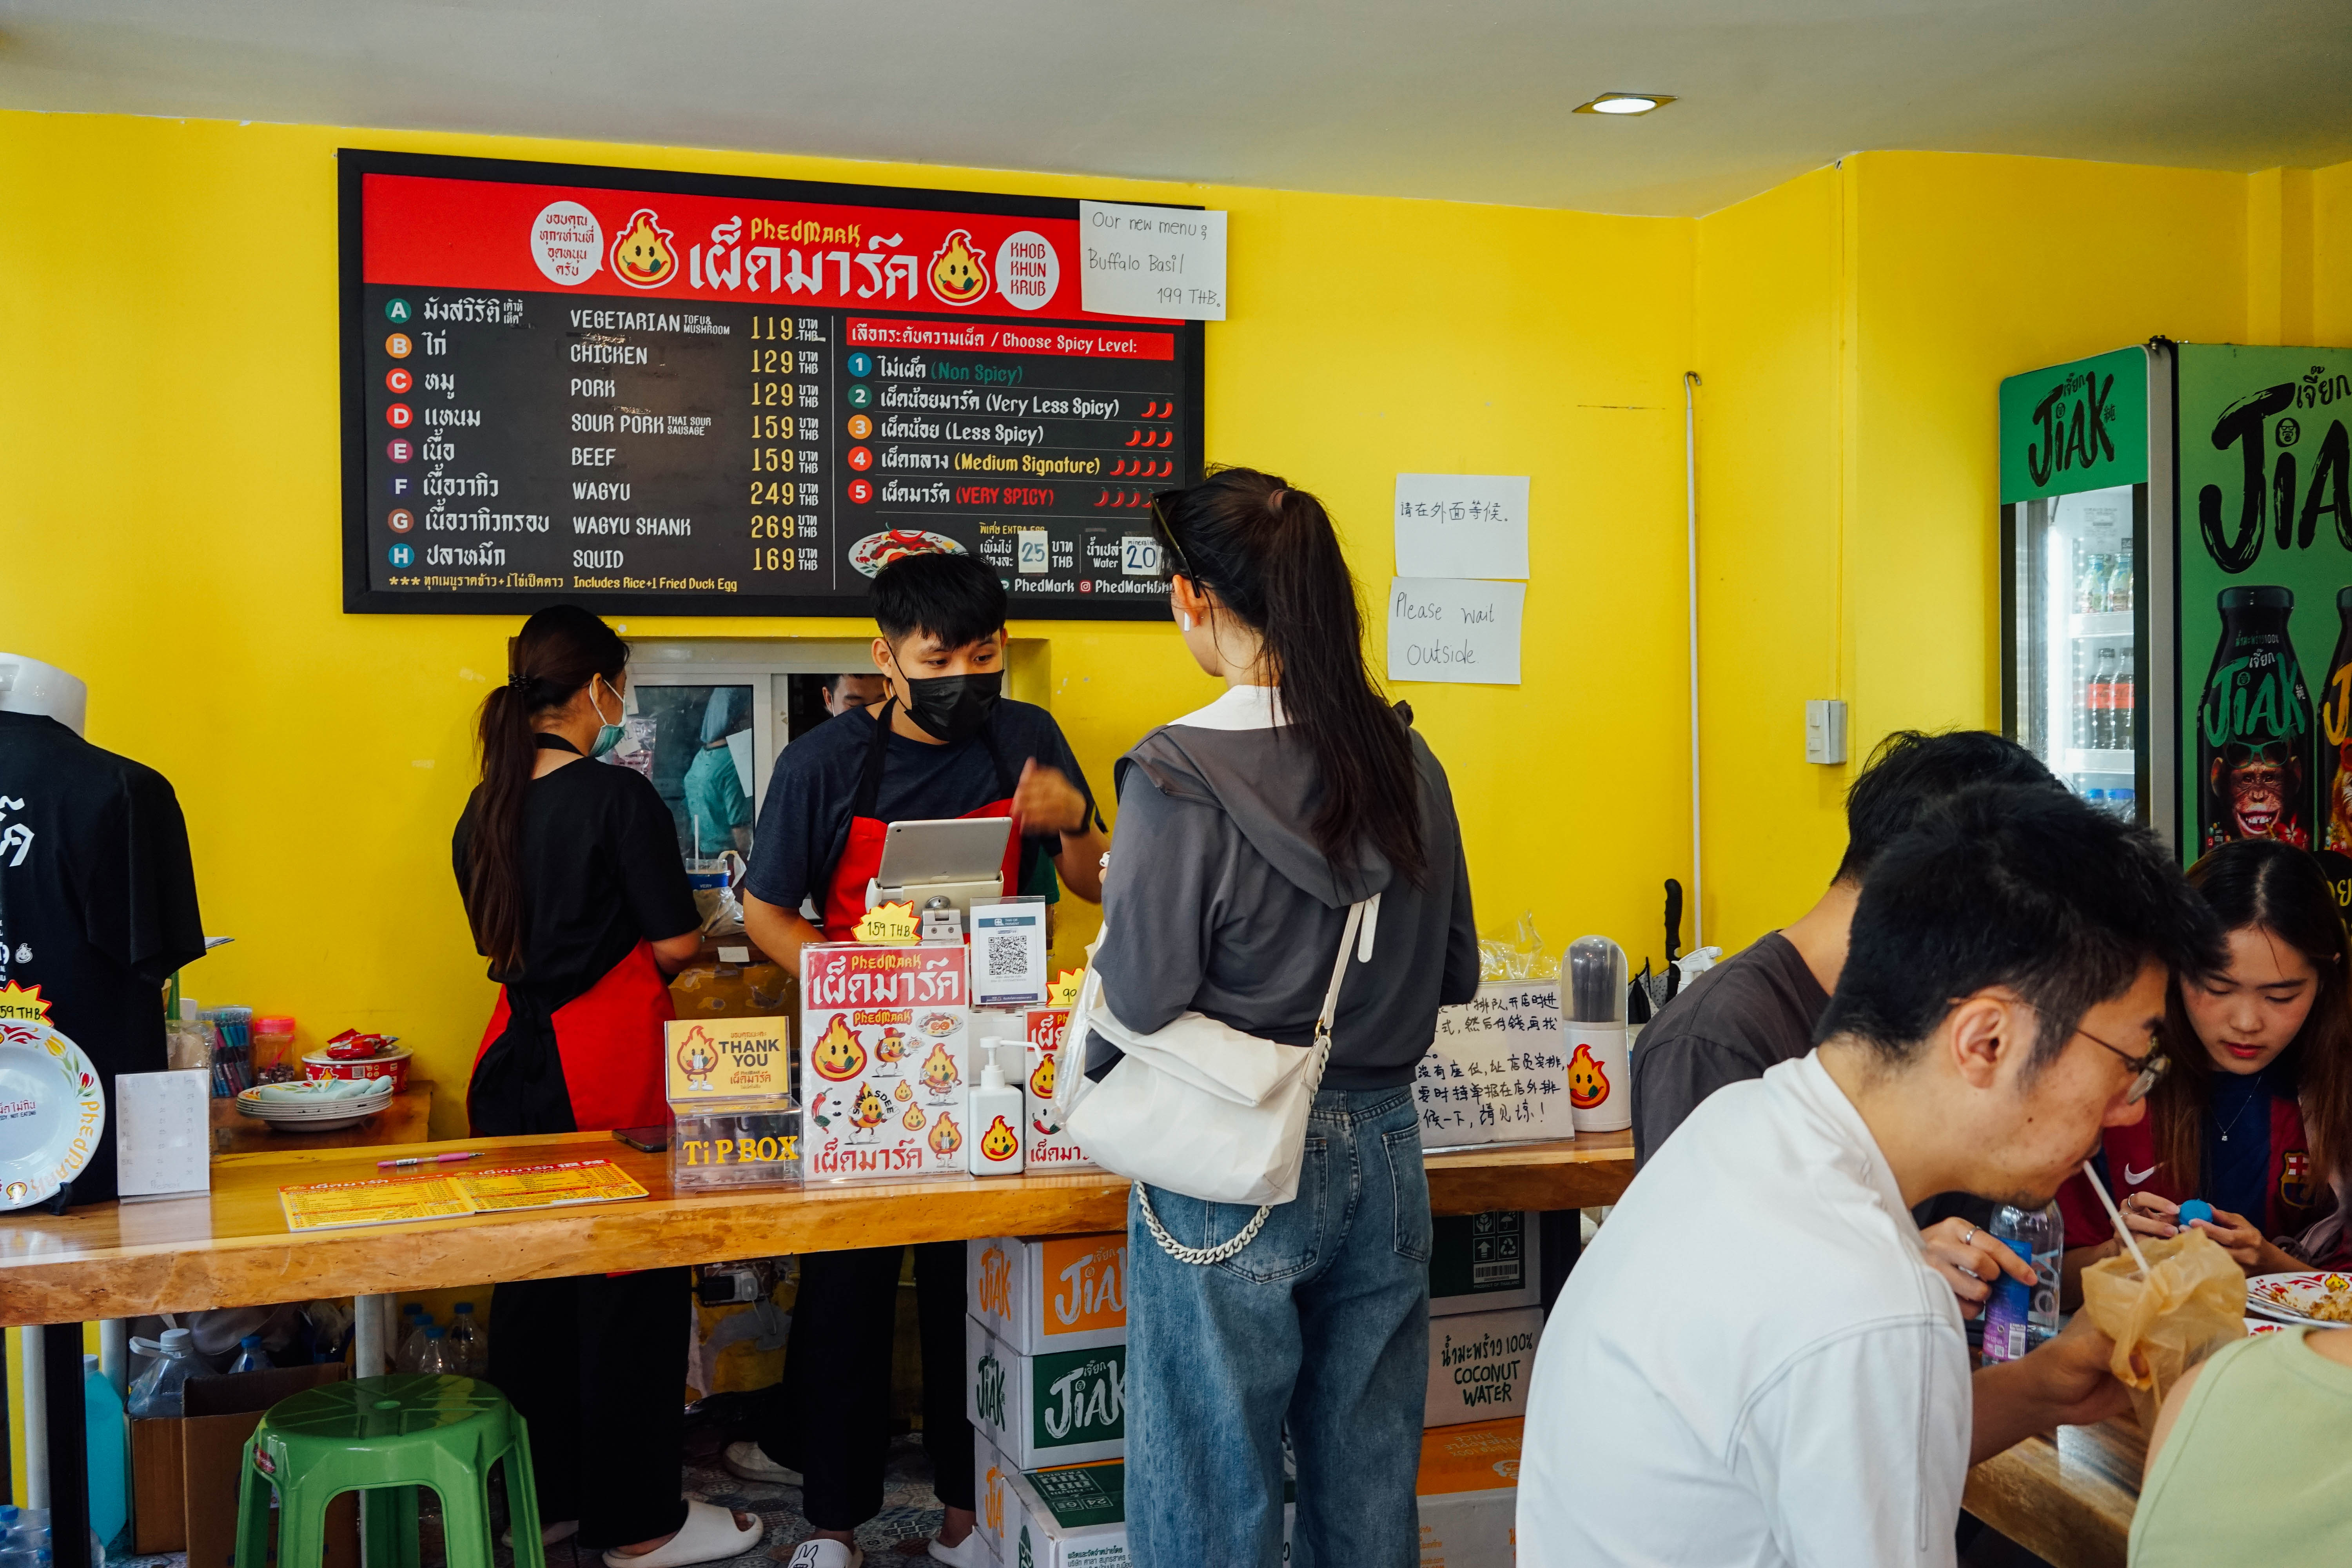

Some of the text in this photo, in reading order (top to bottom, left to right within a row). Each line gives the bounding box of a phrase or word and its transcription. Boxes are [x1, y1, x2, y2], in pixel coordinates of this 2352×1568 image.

[546, 214, 587, 229] ขอบคุณ
[1093, 212, 1152, 231] Our new
[547, 248, 586, 263] อุดหนุน
[690, 215, 918, 301] เผ็ดมาร์ค
[1011, 242, 1046, 259] KHOB
[1089, 247, 1184, 273] Buffalo Basil
[555, 262, 579, 276] ครับ
[1011, 261, 1047, 278] KHUN
[1011, 279, 1046, 296] KRUB
[1158, 287, 1181, 304] 199
[391, 302, 407, 318] A
[424, 296, 500, 323] มังสวิรัติ
[504, 312, 519, 324] เห็ด
[570, 310, 680, 332] VEGETARIAN
[750, 316, 793, 341] 119
[798, 318, 818, 329] บาท
[683, 325, 730, 335] MUSHROOM
[799, 330, 818, 341] THB
[852, 323, 1137, 354] เลือกระดับความเผ็ด Choose Spicy Level:
[393, 338, 407, 354] B
[421, 329, 446, 356] ไก่
[571, 344, 648, 365] CHICKEN
[751, 349, 793, 374] 129
[798, 351, 818, 362] บาท
[799, 363, 818, 374] THB
[855, 358, 863, 371] 1
[877, 355, 1022, 386] ไม่เผ็ด (Non Spicy)
[392, 373, 407, 389] C
[425, 373, 454, 399] หมู
[571, 378, 615, 398] PORK
[751, 382, 793, 407] 129
[799, 385, 818, 396] บาท
[855, 389, 866, 403] 2
[799, 396, 818, 408] THB
[880, 385, 1119, 419] เผ็ดน้อยมาร์ค (Very Less Spicy)
[394, 408, 409, 424] D
[425, 408, 481, 427] แหนม
[572, 414, 664, 434] SOUR PORK
[667, 416, 711, 426] THAI SOUR
[799, 417, 818, 428] บาท
[667, 426, 705, 436] SAUSAGE
[751, 415, 793, 439] 159
[799, 429, 818, 441] THB
[855, 421, 866, 434] 3
[881, 415, 1044, 446] เผ็ดน้อย (Less Spicy)
[394, 443, 407, 459] E
[423, 428, 455, 461] เนื้อ
[572, 447, 616, 466] BEEF
[752, 448, 794, 472] 159
[798, 451, 818, 462] บาท
[854, 452, 866, 465] 4
[881, 445, 1100, 476] เผ็ดกลาง (Medium Signature)
[798, 462, 818, 474] THB
[395, 479, 408, 494] F
[423, 463, 499, 497] เนื้อวากิว
[799, 483, 818, 494] บาท
[572, 482, 630, 501] WAGYU
[751, 481, 794, 505] 249
[799, 494, 818, 506] THB
[855, 485, 866, 499] 5
[882, 479, 1054, 506] เผ็ดมาร์ค (VERY SPICY)
[393, 513, 408, 528] G
[426, 498, 549, 532] เนื้อวากิวกรอบ
[798, 515, 817, 526] บาท
[573, 516, 691, 536] WAGYU SHANK
[751, 515, 794, 539] 269
[798, 526, 817, 537] THB
[979, 521, 1000, 534] พิเศษ
[980, 535, 1012, 554] เพิ่มไข่
[1022, 542, 1045, 562] 25
[1052, 541, 1073, 553] บาท
[394, 548, 408, 564] H
[426, 541, 505, 566] ปลาหมึก
[573, 550, 624, 569] SQUID
[753, 547, 794, 571] 169
[798, 548, 818, 559] บาท
[1052, 555, 1073, 568] THB
[1126, 545, 1156, 569] 20
[798, 559, 818, 571] THB
[1093, 557, 1118, 568] Water
[573, 576, 620, 588] Includes
[659, 577, 686, 589] Fried
[689, 578, 715, 590] Duck
[718, 578, 737, 592] Egg
[1014, 578, 1074, 592] PhedMark
[1396, 592, 1442, 621] Please
[867, 922, 886, 936] 159
[813, 955, 958, 1005] เผ็ดมาร์ค
[1063, 988, 1077, 1002] 90
[718, 1039, 780, 1054] THANK
[732, 1054, 768, 1067] YOU
[738, 1135, 799, 1163] BOX
[814, 1137, 922, 1173] เผ็ดมาร์ค
[1441, 1332, 1533, 1367] น้ำมะพร้าว 100%
[1454, 1360, 1521, 1385] COCONUT
[1463, 1382, 1512, 1406] WATER
